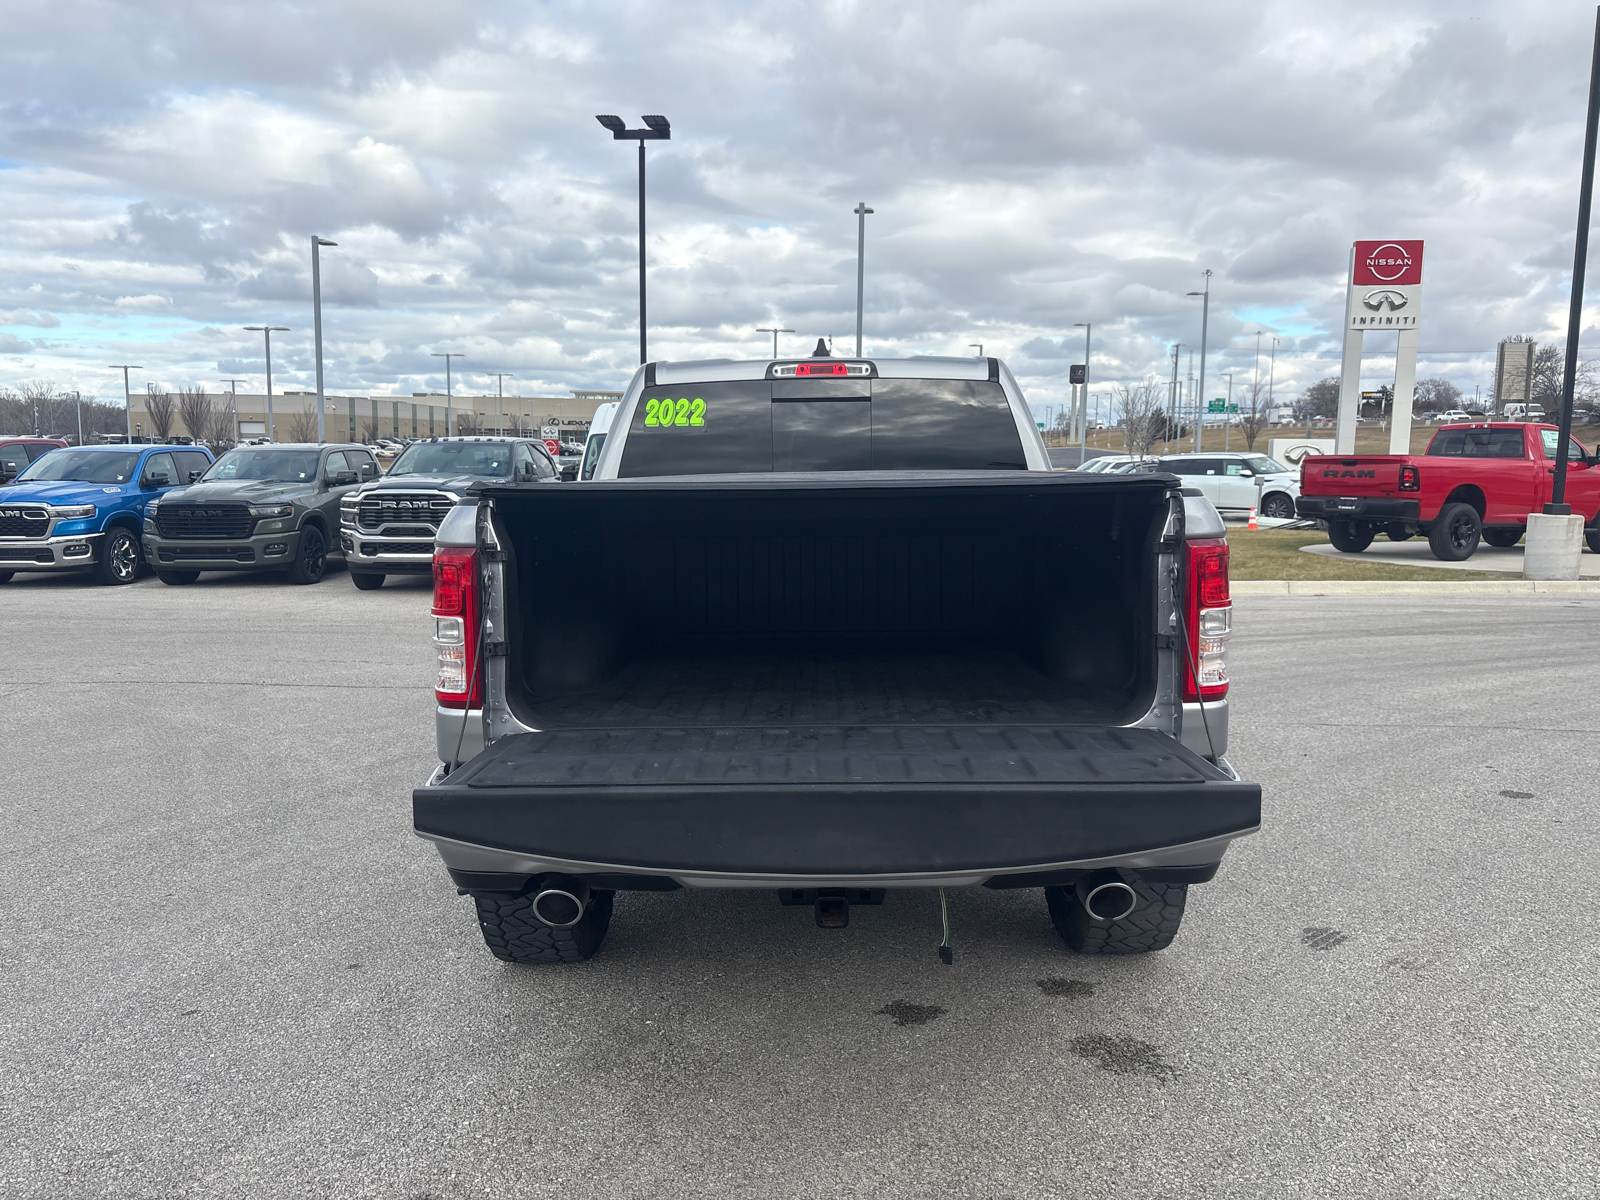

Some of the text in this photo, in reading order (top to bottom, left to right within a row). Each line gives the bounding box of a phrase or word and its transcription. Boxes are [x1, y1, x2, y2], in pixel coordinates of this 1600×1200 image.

[1352, 316, 1416, 324] INFINITI
[644, 398, 707, 427] 2022
[1323, 470, 1375, 478] RAM
[381, 501, 429, 509] RAM
